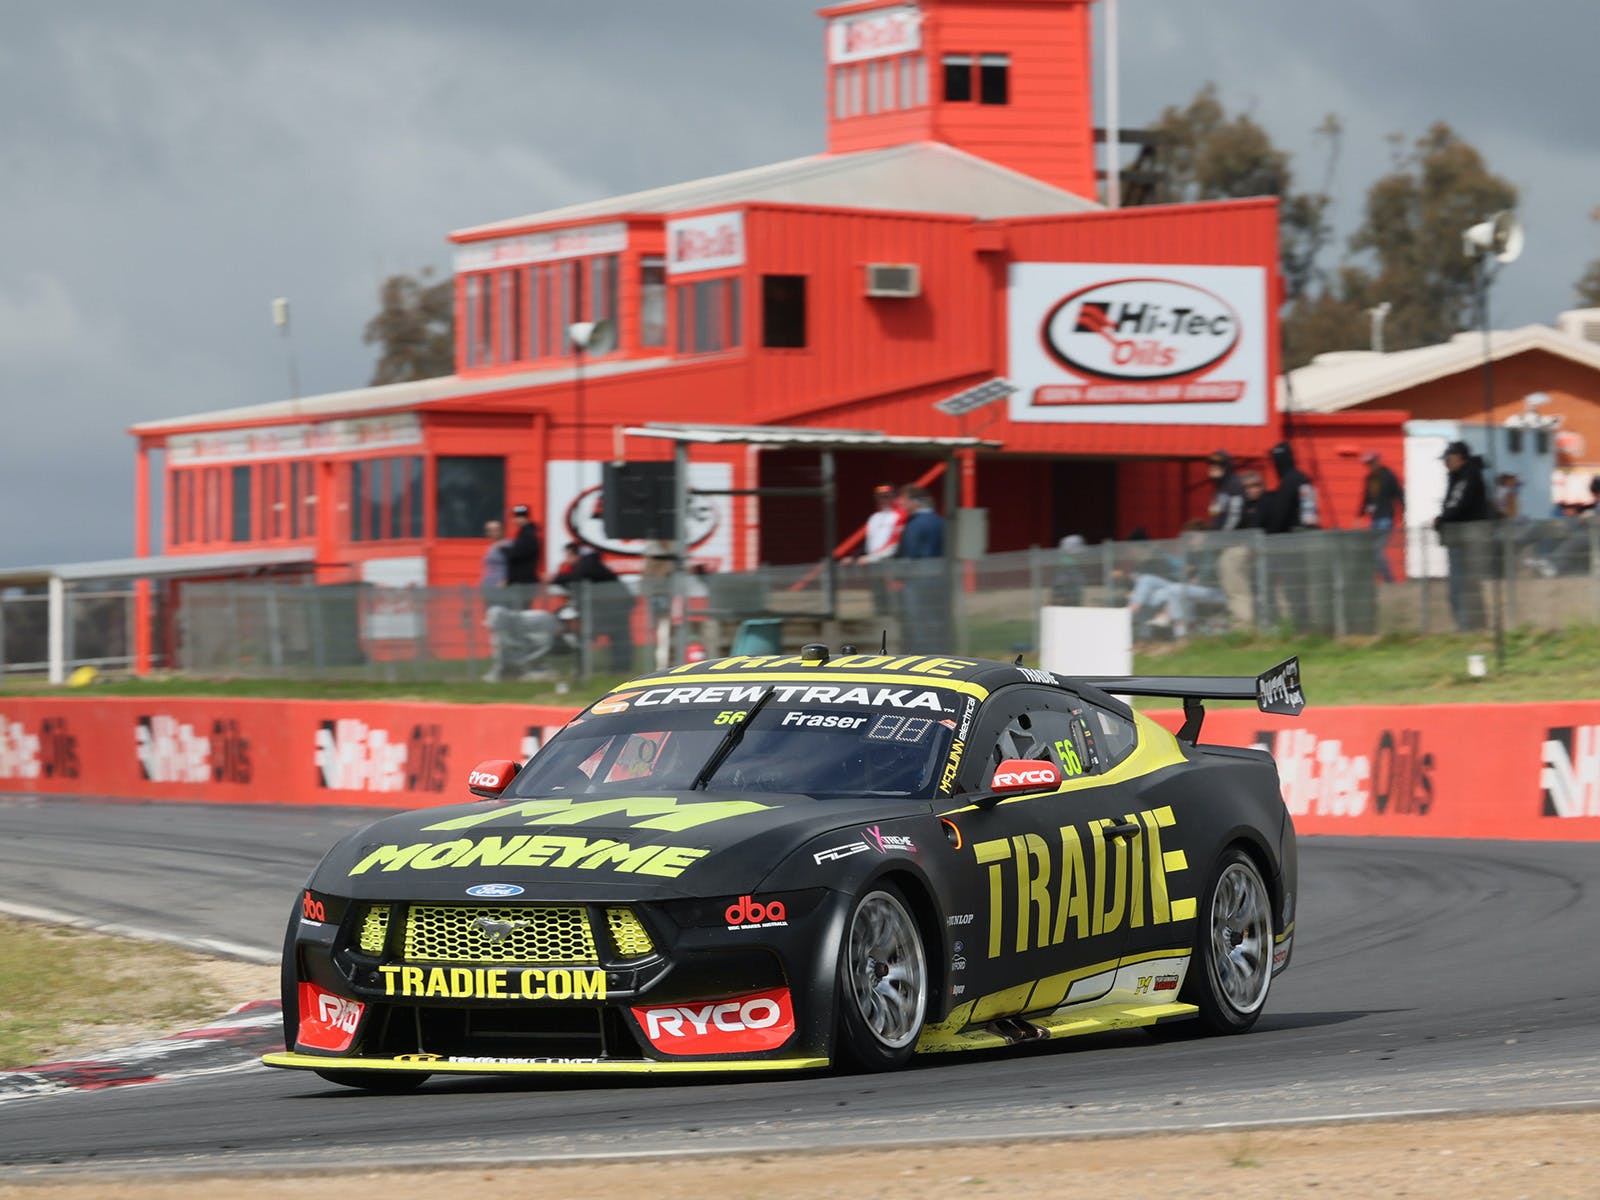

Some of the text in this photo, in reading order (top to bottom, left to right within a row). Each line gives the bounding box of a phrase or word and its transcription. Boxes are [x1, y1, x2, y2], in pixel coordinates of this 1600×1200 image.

[1116, 302, 1231, 336] Hi-Tec
[1111, 339, 1177, 367] Oils
[1015, 667, 1059, 685] TRADIE
[633, 686, 943, 712] CREWTRAKA
[713, 710, 747, 726] 56
[781, 711, 868, 730] Fraser
[958, 696, 976, 742] electrical
[1054, 739, 1083, 777] 56
[993, 769, 1056, 787] RYCO
[348, 835, 711, 878] MONEYME
[973, 805, 1197, 959] TRADIE
[303, 890, 325, 921] dba
[725, 895, 786, 925] dba
[378, 965, 607, 1000] TRADIE.COM
[646, 998, 781, 1040] RYCO
